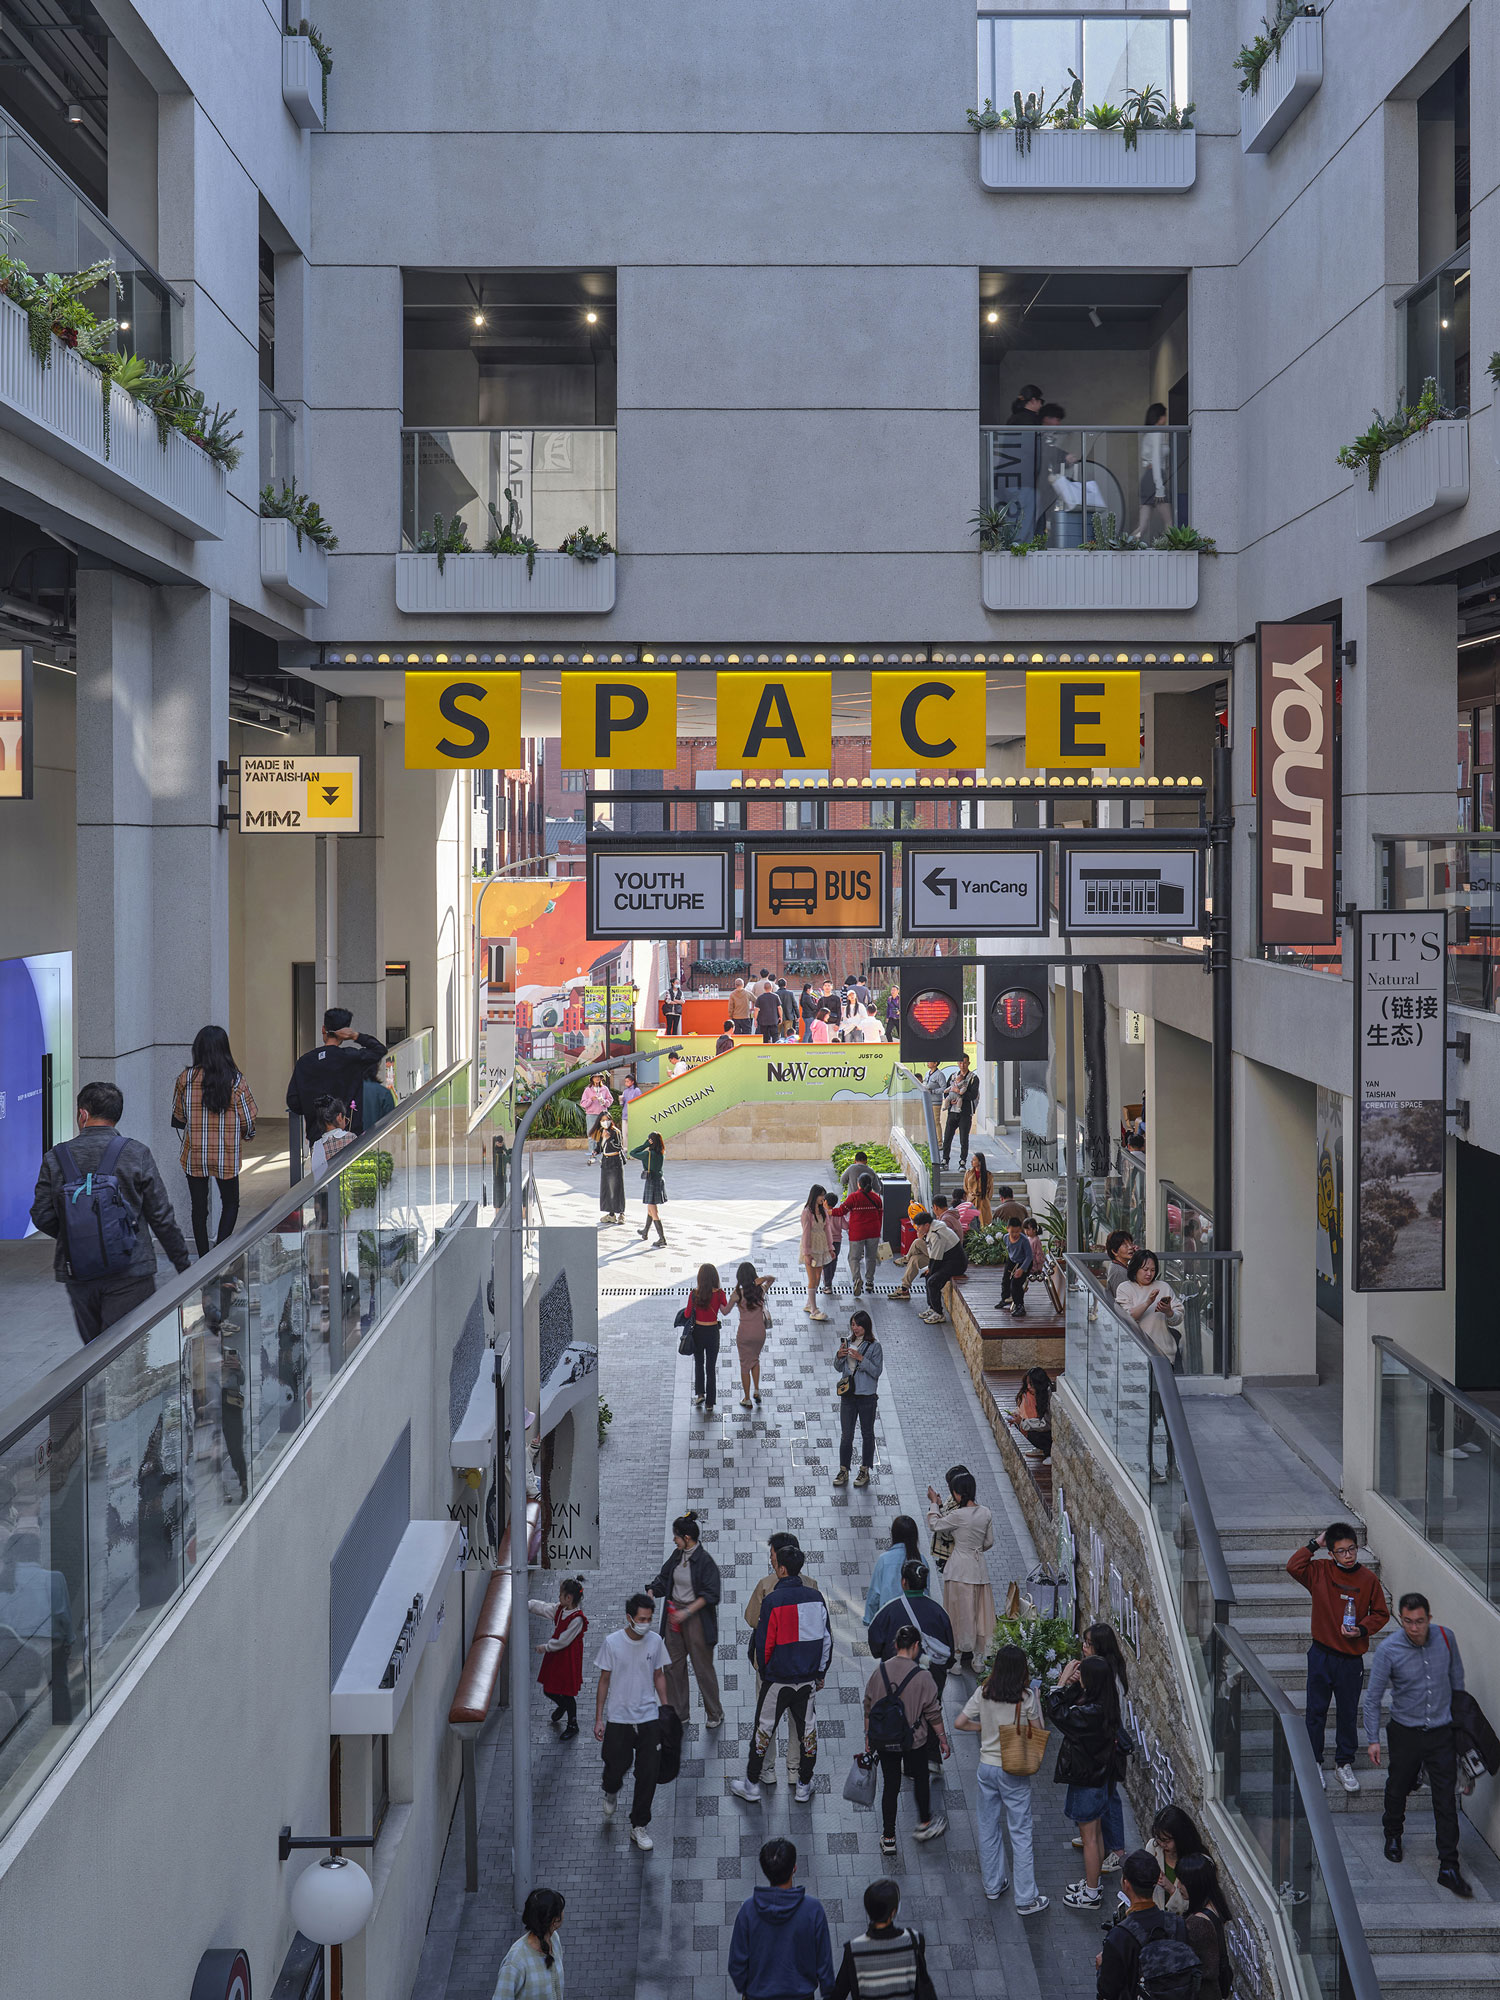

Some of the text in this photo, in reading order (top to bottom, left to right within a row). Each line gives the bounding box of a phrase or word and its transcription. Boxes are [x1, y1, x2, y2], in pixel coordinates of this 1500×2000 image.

[435, 682, 1107, 760] SPACE
[245, 760, 295, 770] MADE IN
[245, 772, 320, 782] YANTAISHAN
[1270, 644, 1325, 915] YOUTH
[245, 810, 301, 827] M1M2
[614, 872, 685, 889] YOUTH
[825, 870, 872, 901] BUS
[962, 880, 1028, 897] YanCang
[613, 893, 705, 910] CULTURE
[1367, 972, 1420, 986] Natural
[650, 1084, 715, 1124] YANTAISHAN
[1365, 1101, 1424, 1109] CREATIVE SPACE
[1026, 1136, 1048, 1147] YAN
[1026, 1162, 1054, 1173] SHAN
[446, 1503, 478, 1518] YAN
[551, 1503, 581, 1518] YAN
[457, 1546, 490, 1561] HAN
[549, 1545, 592, 1560] SHAN
